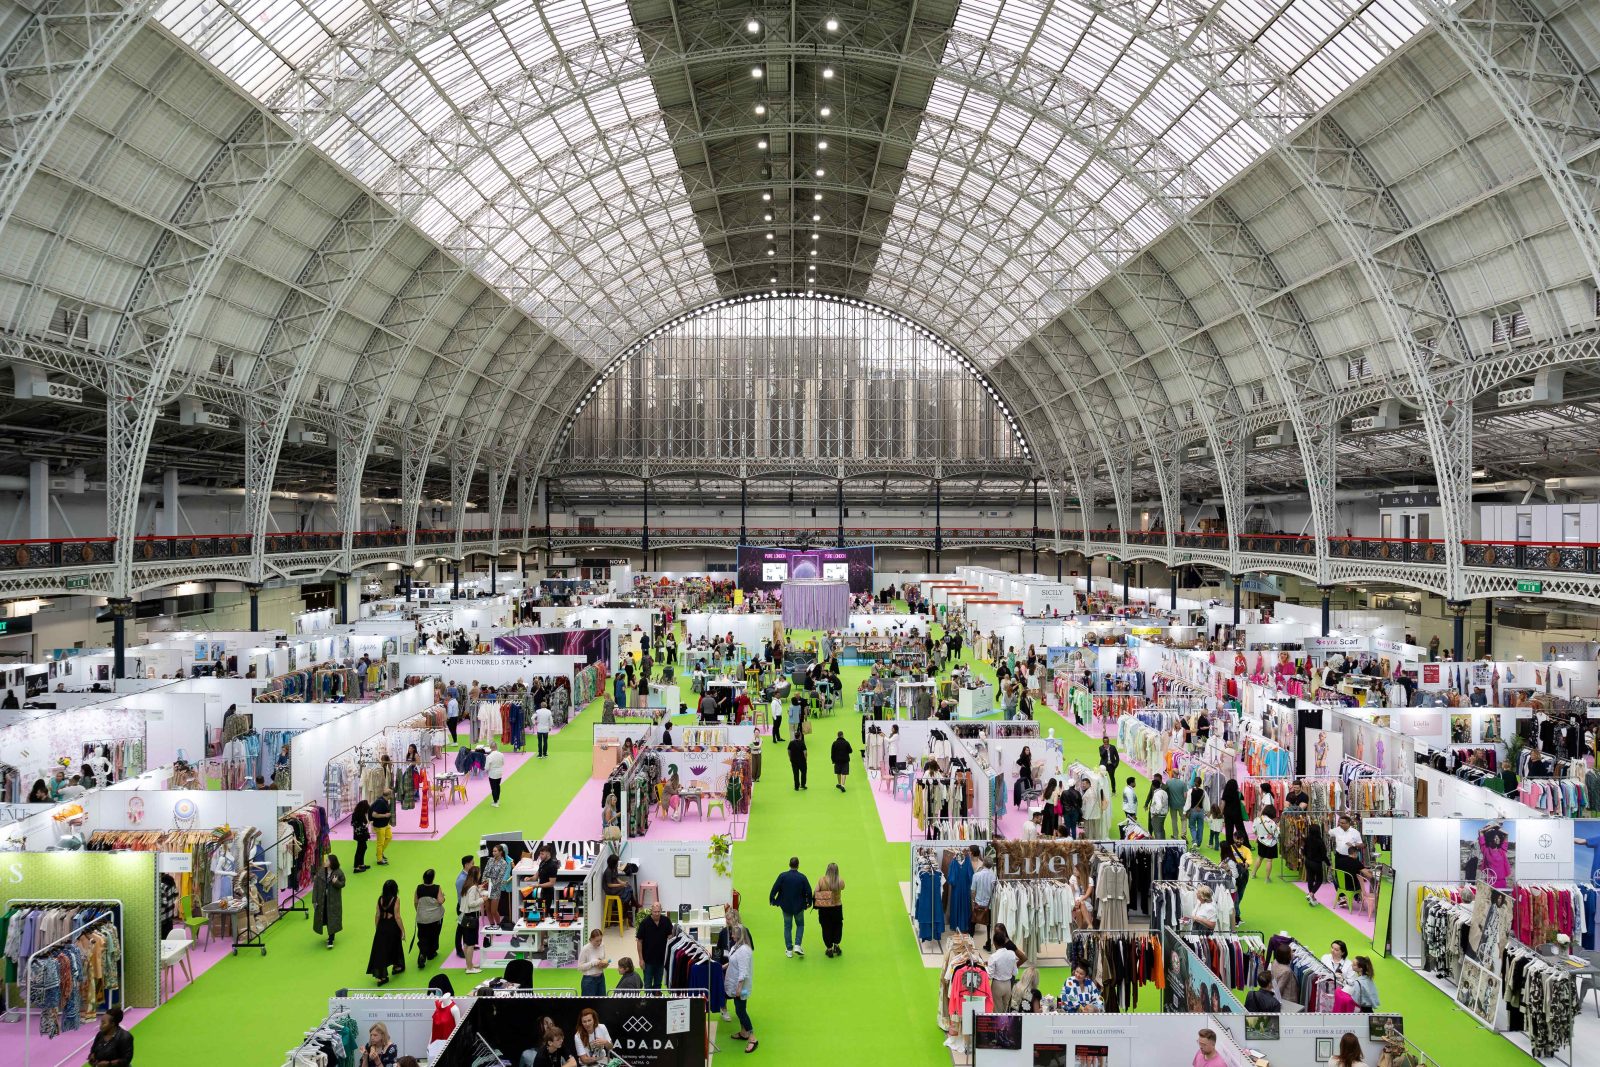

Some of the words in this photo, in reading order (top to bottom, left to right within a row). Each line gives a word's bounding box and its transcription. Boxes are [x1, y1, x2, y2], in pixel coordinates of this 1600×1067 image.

[1339, 638, 1359, 646] Scarf
[683, 752, 714, 760] MOVOM
[1534, 852, 1556, 860] NOEN
[612, 1038, 675, 1050] ADADA
